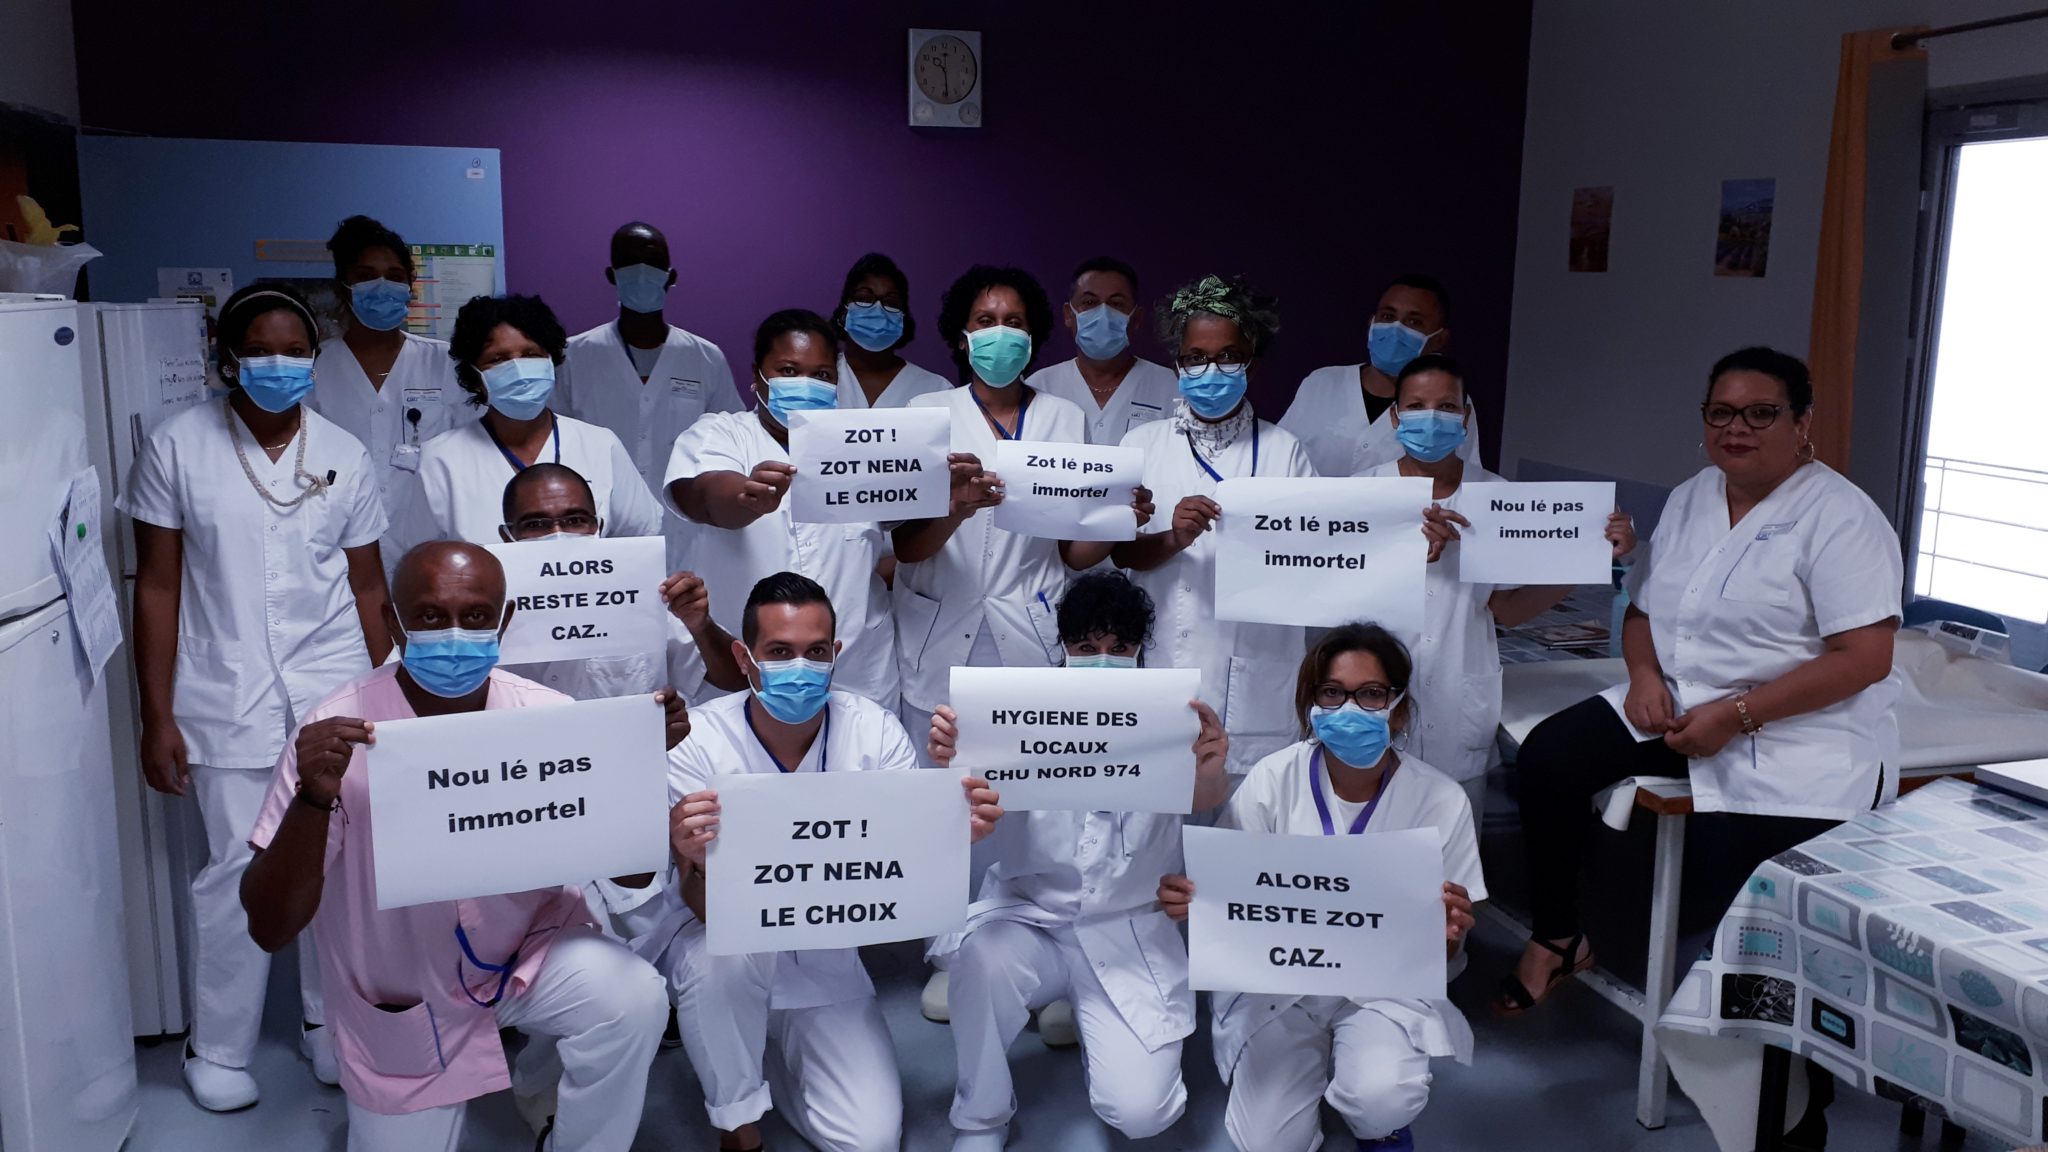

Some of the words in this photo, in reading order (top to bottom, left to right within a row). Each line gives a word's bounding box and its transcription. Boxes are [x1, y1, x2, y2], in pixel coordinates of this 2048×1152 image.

[844, 428, 885, 444] ZOT
[891, 428, 897, 443] !
[820, 460, 861, 476] ZOT
[867, 458, 923, 474] NENA
[1026, 455, 1057, 469] Zot
[1061, 457, 1078, 471] lé
[1082, 462, 1114, 474] pas
[825, 491, 850, 506] LE
[855, 487, 918, 504] CHOIX
[1032, 482, 1110, 499] immortel
[1490, 499, 1525, 512] Nou
[1531, 499, 1547, 512] lé
[1552, 502, 1584, 515] pas
[1254, 514, 1293, 532] Zot
[1300, 515, 1321, 532] lé
[1328, 520, 1370, 537] pas
[1499, 526, 1579, 539] immortel
[539, 559, 614, 577] ALORS
[1265, 549, 1366, 570] immortel
[516, 592, 589, 611] RESTE
[595, 589, 640, 607] ZOT
[551, 623, 608, 641] CAZ..
[992, 709, 1089, 726] HYGIENE
[1096, 711, 1138, 727] DES
[1020, 739, 1109, 755] LOCAUX
[427, 768, 490, 790] Nou
[500, 759, 528, 782] lé
[538, 756, 592, 782] pas
[984, 768, 1030, 781] CHU
[1037, 765, 1097, 779] NORD
[1103, 763, 1141, 778] 974
[448, 796, 585, 833] immortel
[791, 819, 852, 840] ZOT
[860, 819, 868, 838] !
[753, 863, 814, 885] ZOT
[824, 860, 904, 882] NENA
[1255, 871, 1351, 893] ALORS
[760, 906, 796, 928] LE
[805, 901, 897, 925] CHOIX
[1227, 902, 1318, 925] RESTE
[1326, 910, 1384, 929] ZOT
[1269, 946, 1342, 969] CAZ..
